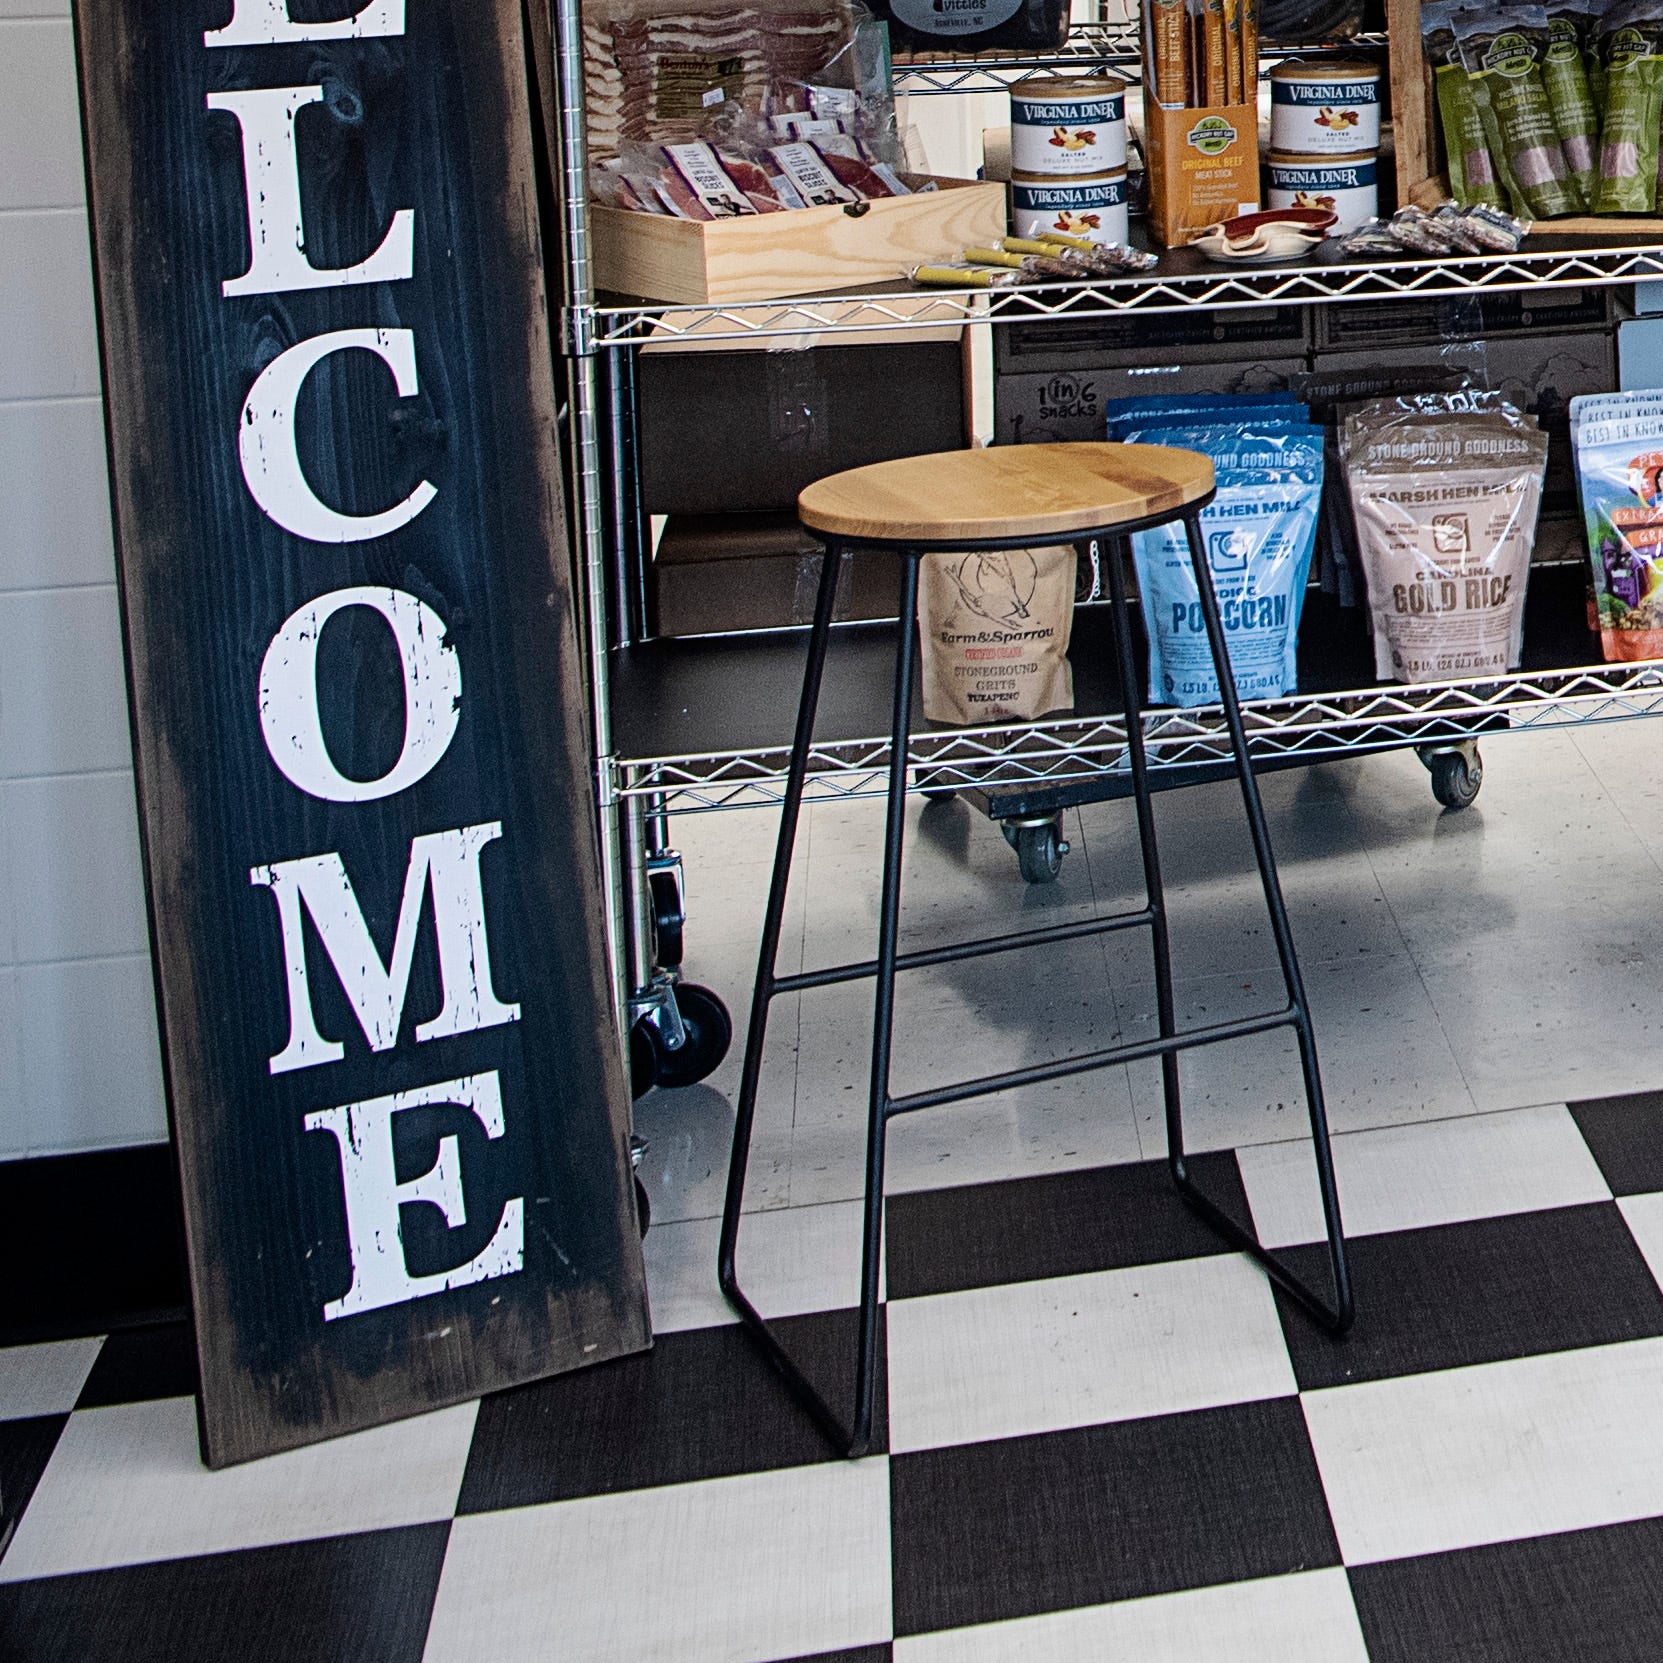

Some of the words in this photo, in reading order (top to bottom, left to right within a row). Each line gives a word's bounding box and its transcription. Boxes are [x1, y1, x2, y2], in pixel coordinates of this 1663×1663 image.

[1288, 85, 1344, 102] VIRGINIA
[1345, 84, 1376, 102] DINER
[1023, 102, 1079, 120] VIRGINIA
[1080, 102, 1116, 119] DINER
[1038, 400, 1097, 420] snacks
[1586, 430, 1610, 444] BEST
[1616, 425, 1629, 438] IN
[1393, 582, 1457, 614] GOLD
[954, 662, 1038, 678] STONEGROUND
[976, 679, 1016, 691] GRITS
